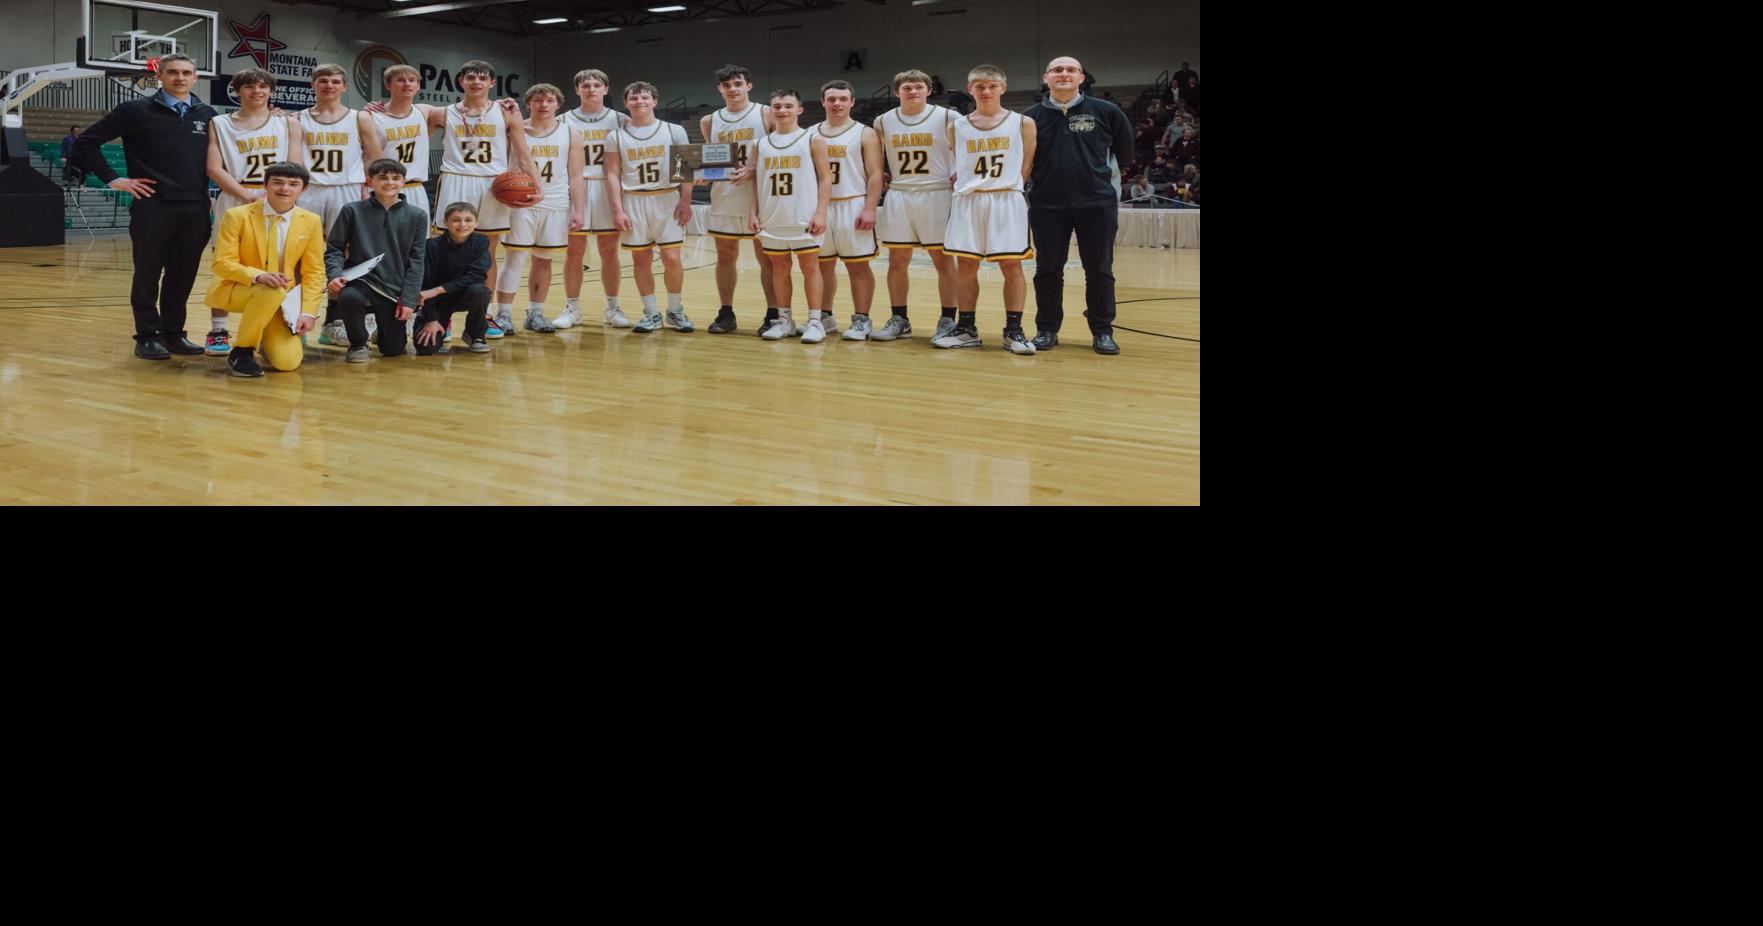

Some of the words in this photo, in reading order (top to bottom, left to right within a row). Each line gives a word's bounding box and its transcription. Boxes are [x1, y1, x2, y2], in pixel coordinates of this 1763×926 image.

[269, 53, 318, 67] MONTANA
[269, 63, 299, 77] STATE
[301, 67, 313, 78] FA
[845, 52, 863, 71] A
[275, 85, 288, 93] HE
[288, 86, 315, 95] OFFIC
[419, 63, 520, 98] PACIC
[270, 92, 318, 103] BEVERA
[419, 92, 450, 103] STEEL
[305, 131, 349, 146] RAMS
[892, 132, 934, 148] RAMS
[966, 136, 1010, 153] RAMS
[311, 149, 344, 173] 20
[461, 140, 493, 164] 23
[530, 144, 560, 158] AMS
[583, 144, 605, 167] 12
[626, 145, 667, 161] RAMS
[737, 144, 748, 167] 4
[246, 152, 277, 179] 25
[535, 160, 553, 183] 4
[898, 150, 930, 174] 22
[974, 153, 1005, 179] 45
[637, 161, 661, 185] 15
[769, 172, 794, 196] 13
